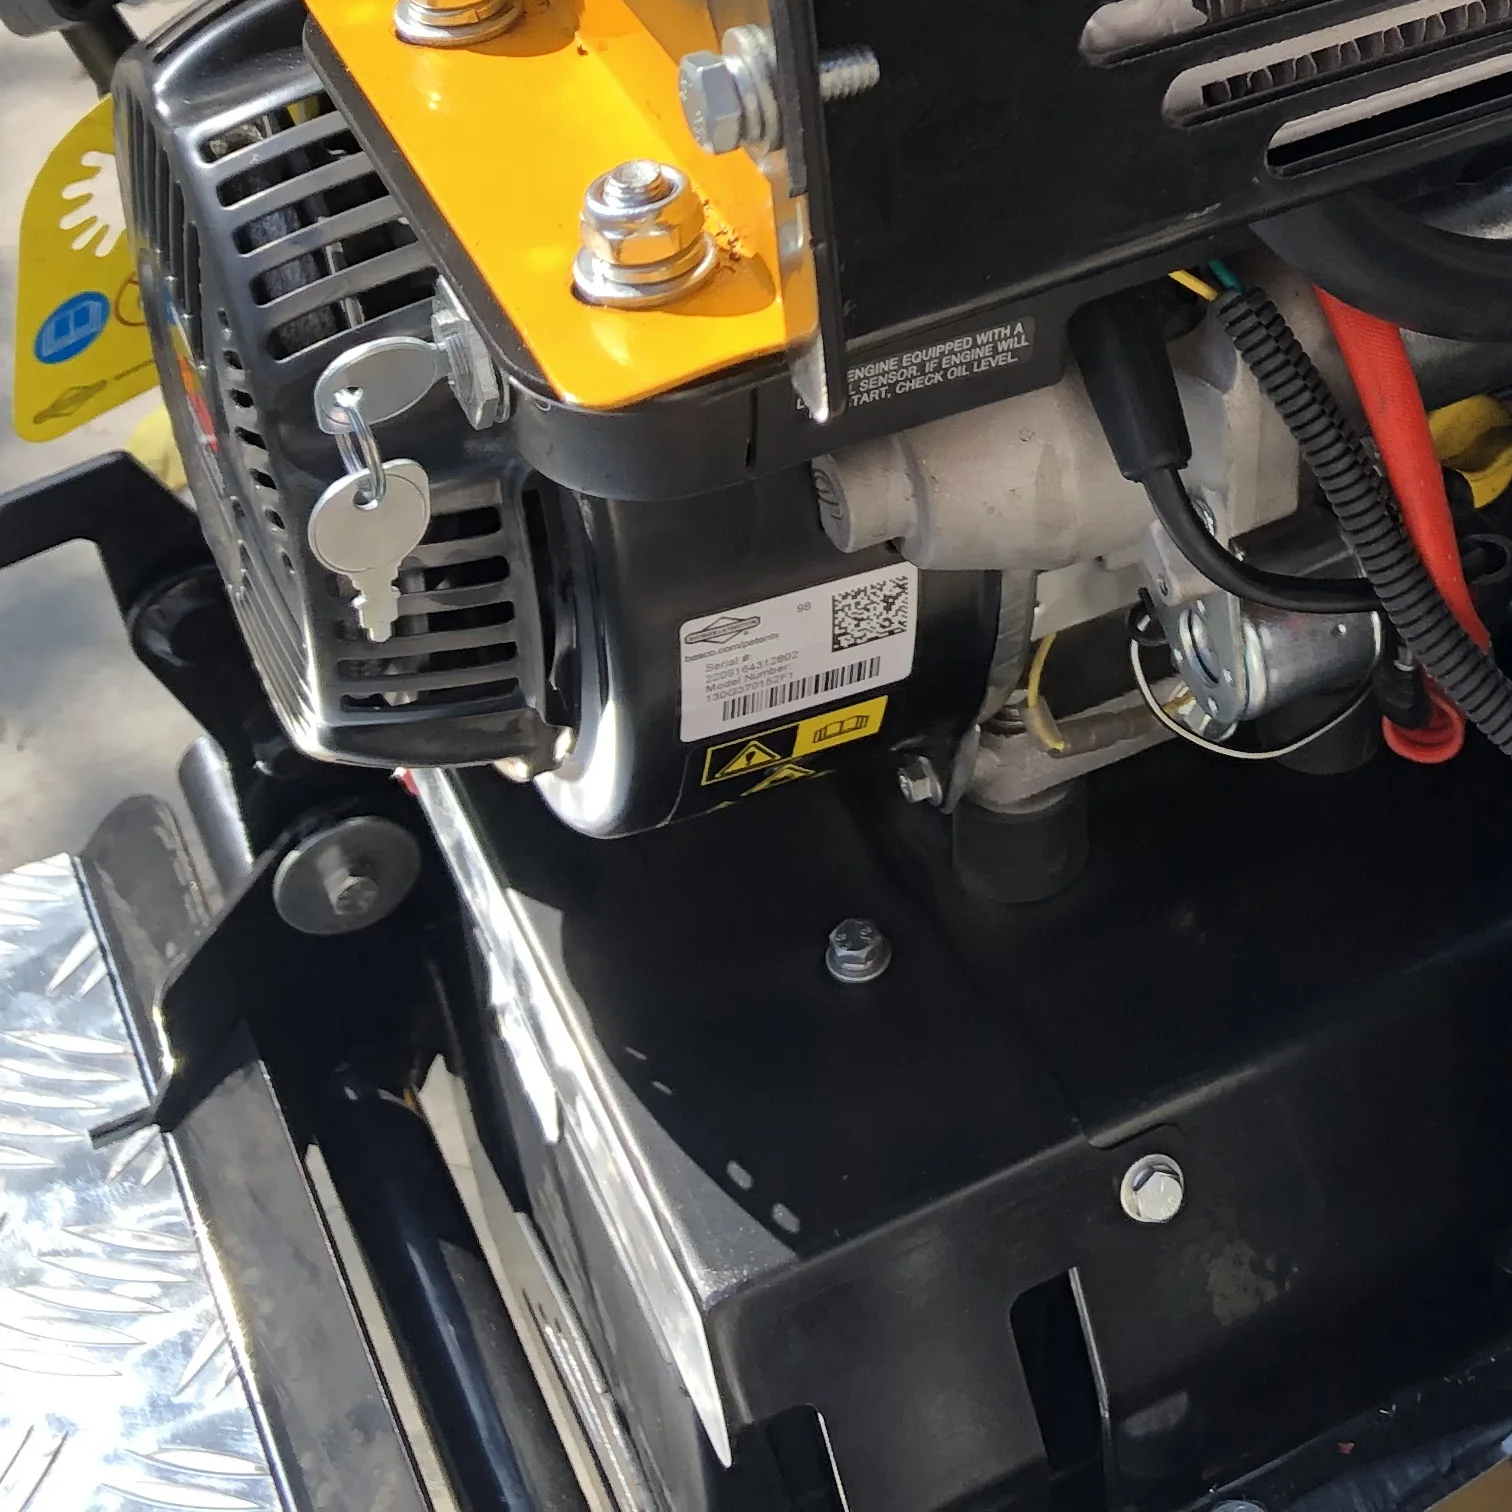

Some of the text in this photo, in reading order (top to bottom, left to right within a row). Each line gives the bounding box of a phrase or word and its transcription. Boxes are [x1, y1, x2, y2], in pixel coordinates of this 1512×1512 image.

[847, 322, 1024, 383] ENGINE EQUIPPED WITH A
[859, 365, 921, 392] SENSOR.
[925, 359, 939, 373] IF
[941, 343, 995, 369] ENGINE
[997, 335, 1030, 353] WILL
[848, 386, 892, 407] TART,
[895, 370, 944, 394] CHECK
[947, 364, 970, 380] OIL
[705, 656, 739, 673] Serial
[705, 677, 741, 693] Model
